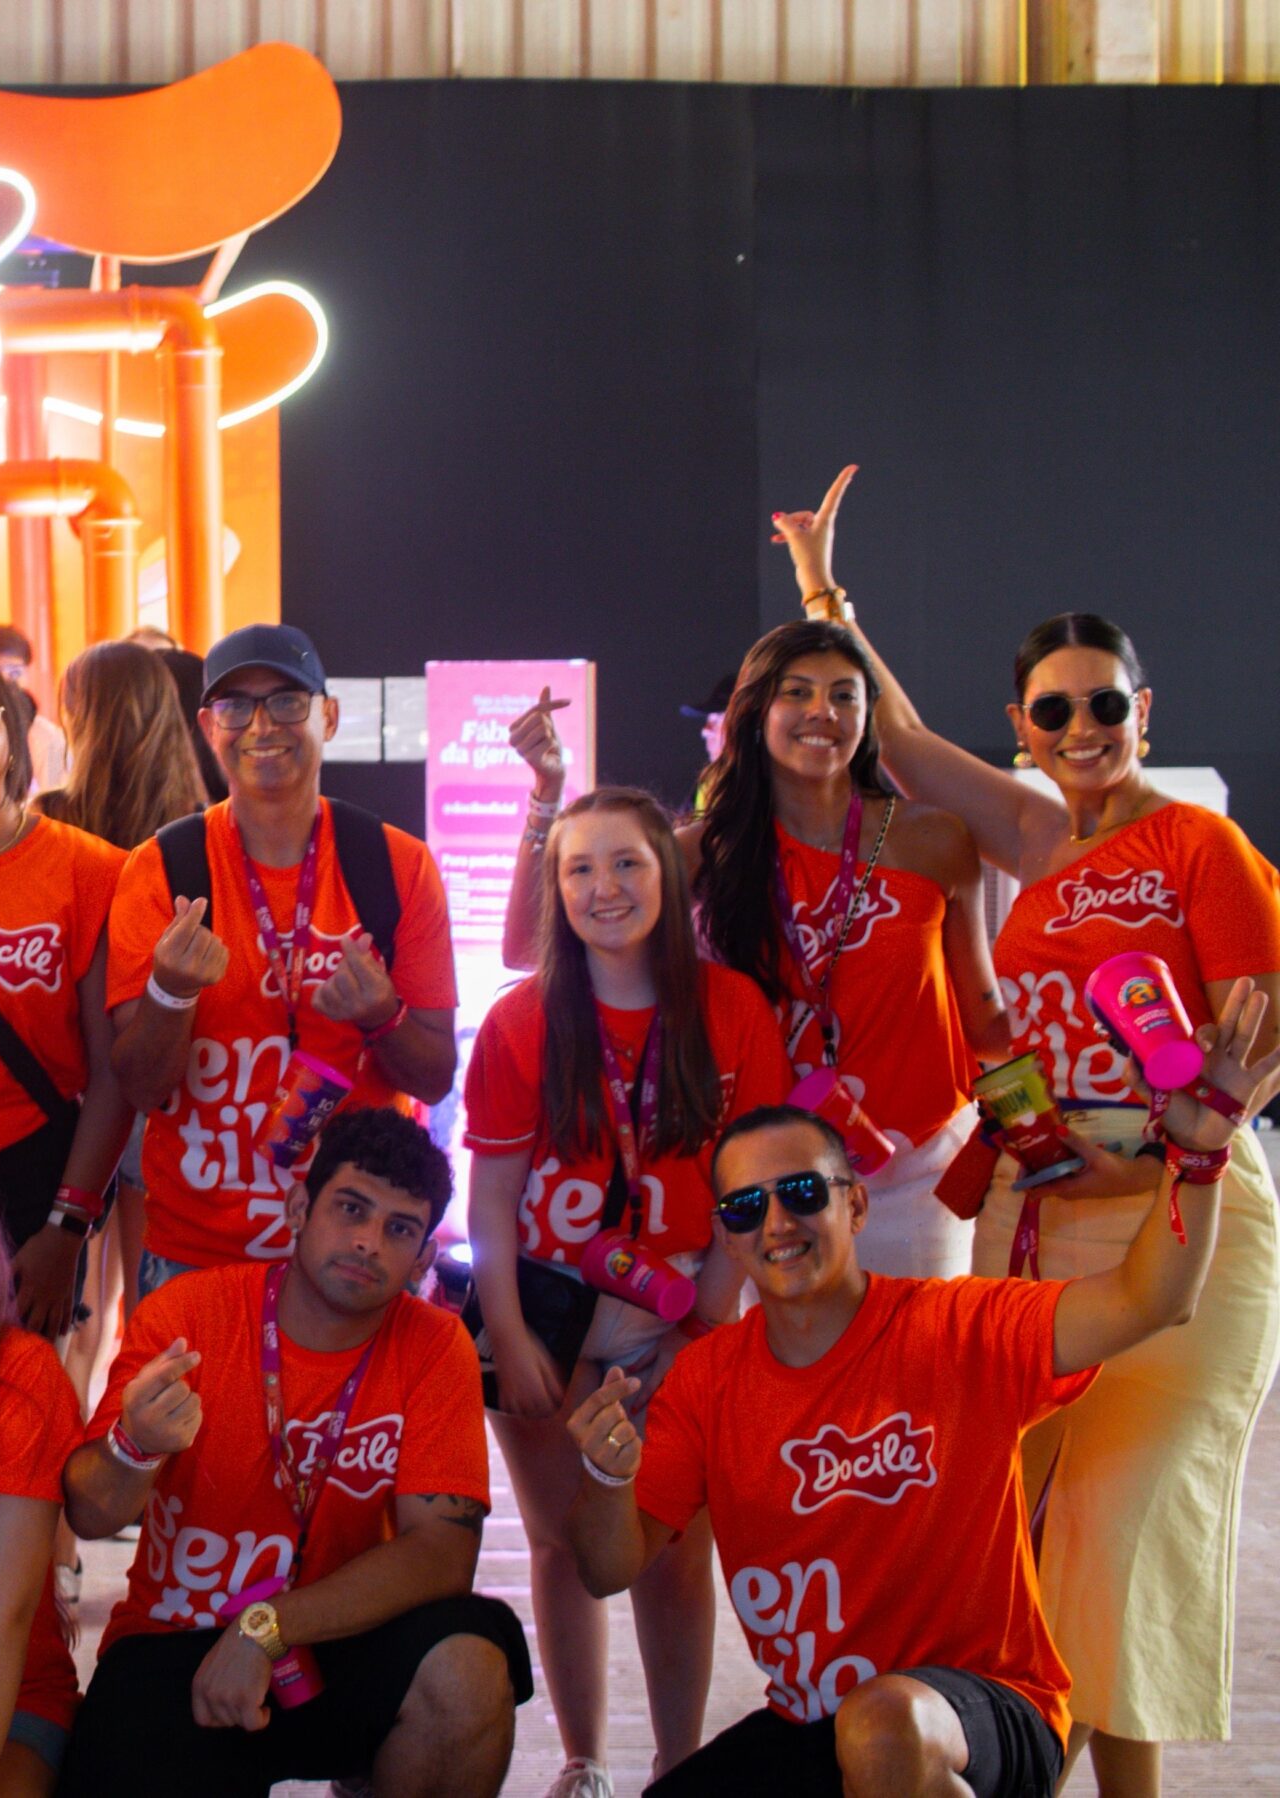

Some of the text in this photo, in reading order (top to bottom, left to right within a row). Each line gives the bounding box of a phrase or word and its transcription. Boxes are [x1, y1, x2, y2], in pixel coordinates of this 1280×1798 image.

[1071, 875, 1178, 918] Docile
[183, 1035, 292, 1104] en
[808, 1431, 923, 1493] Docile
